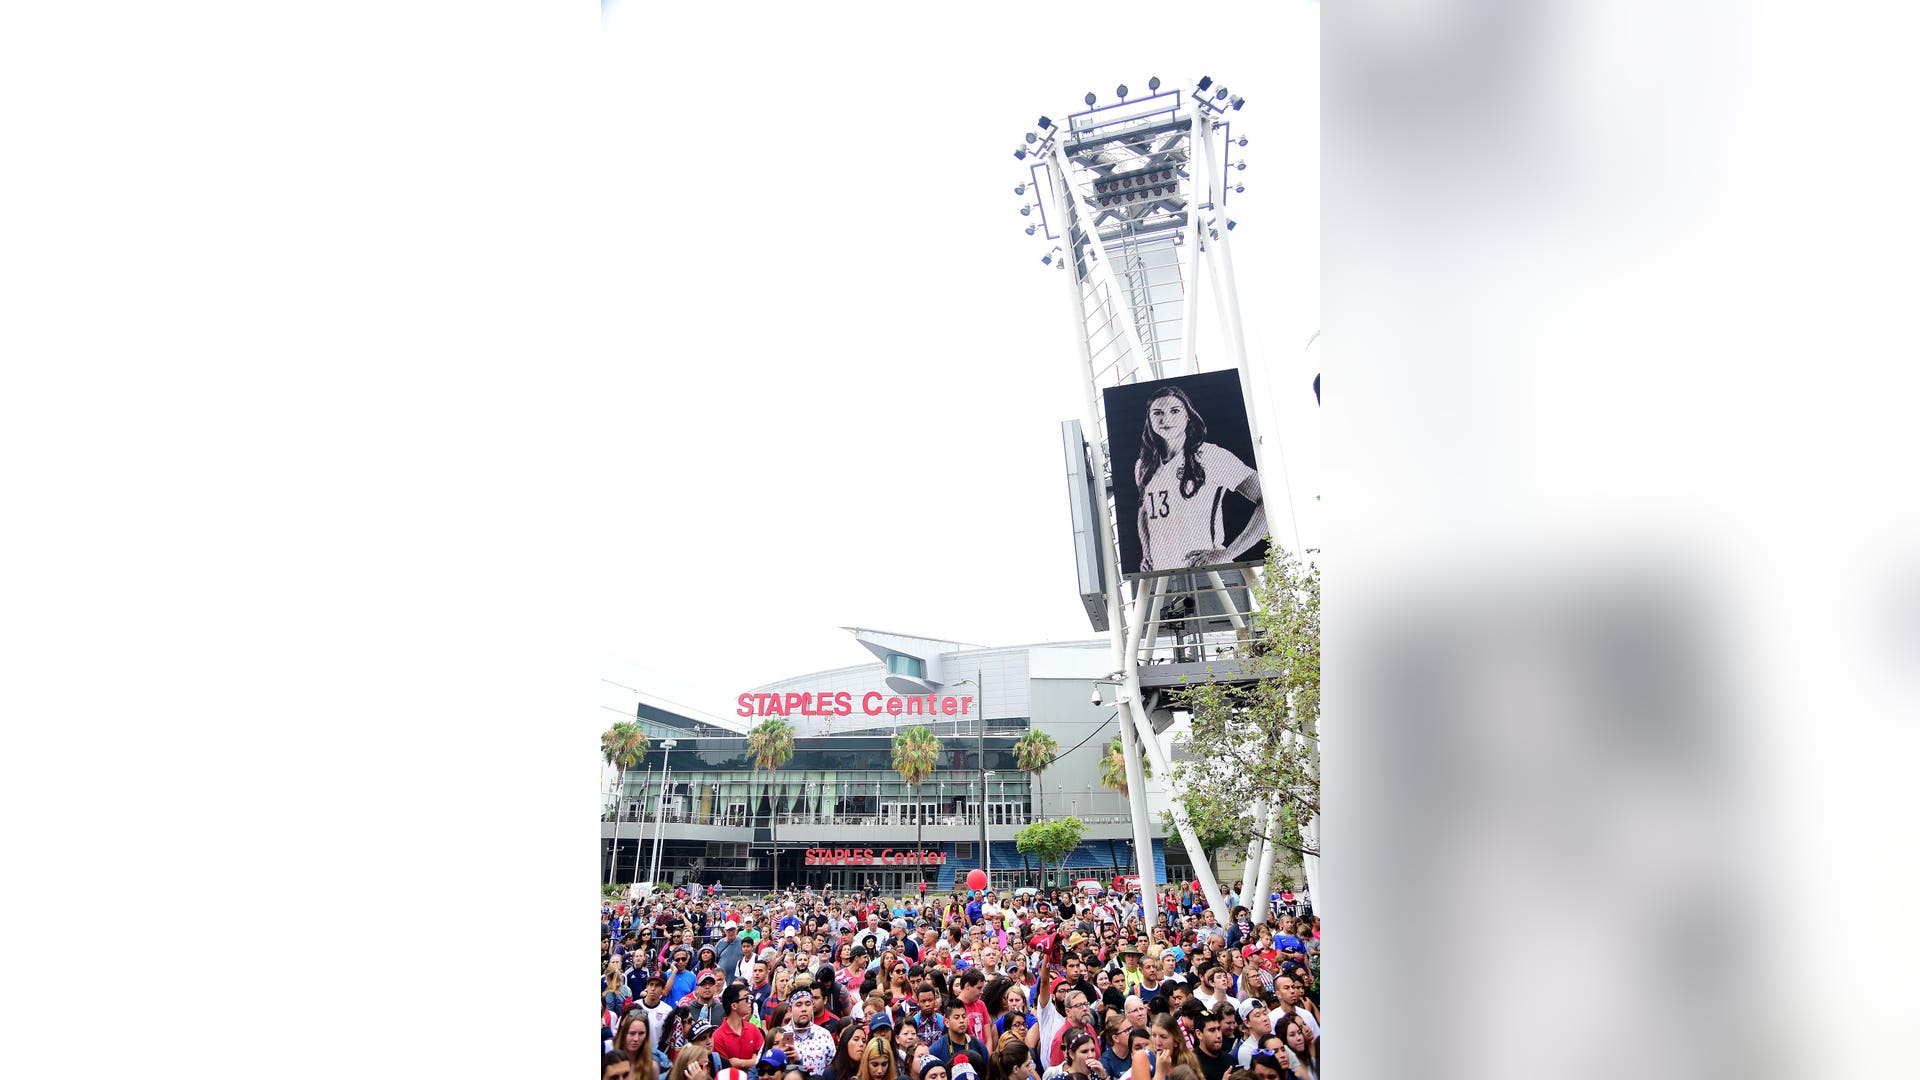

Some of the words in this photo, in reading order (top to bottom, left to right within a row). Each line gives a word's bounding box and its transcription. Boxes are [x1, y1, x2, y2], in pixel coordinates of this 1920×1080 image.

[1148, 490, 1169, 519] 13
[737, 691, 852, 717] STAPLES
[862, 691, 973, 715] Center
[805, 848, 874, 865] STAPLES
[881, 848, 947, 865] Center
